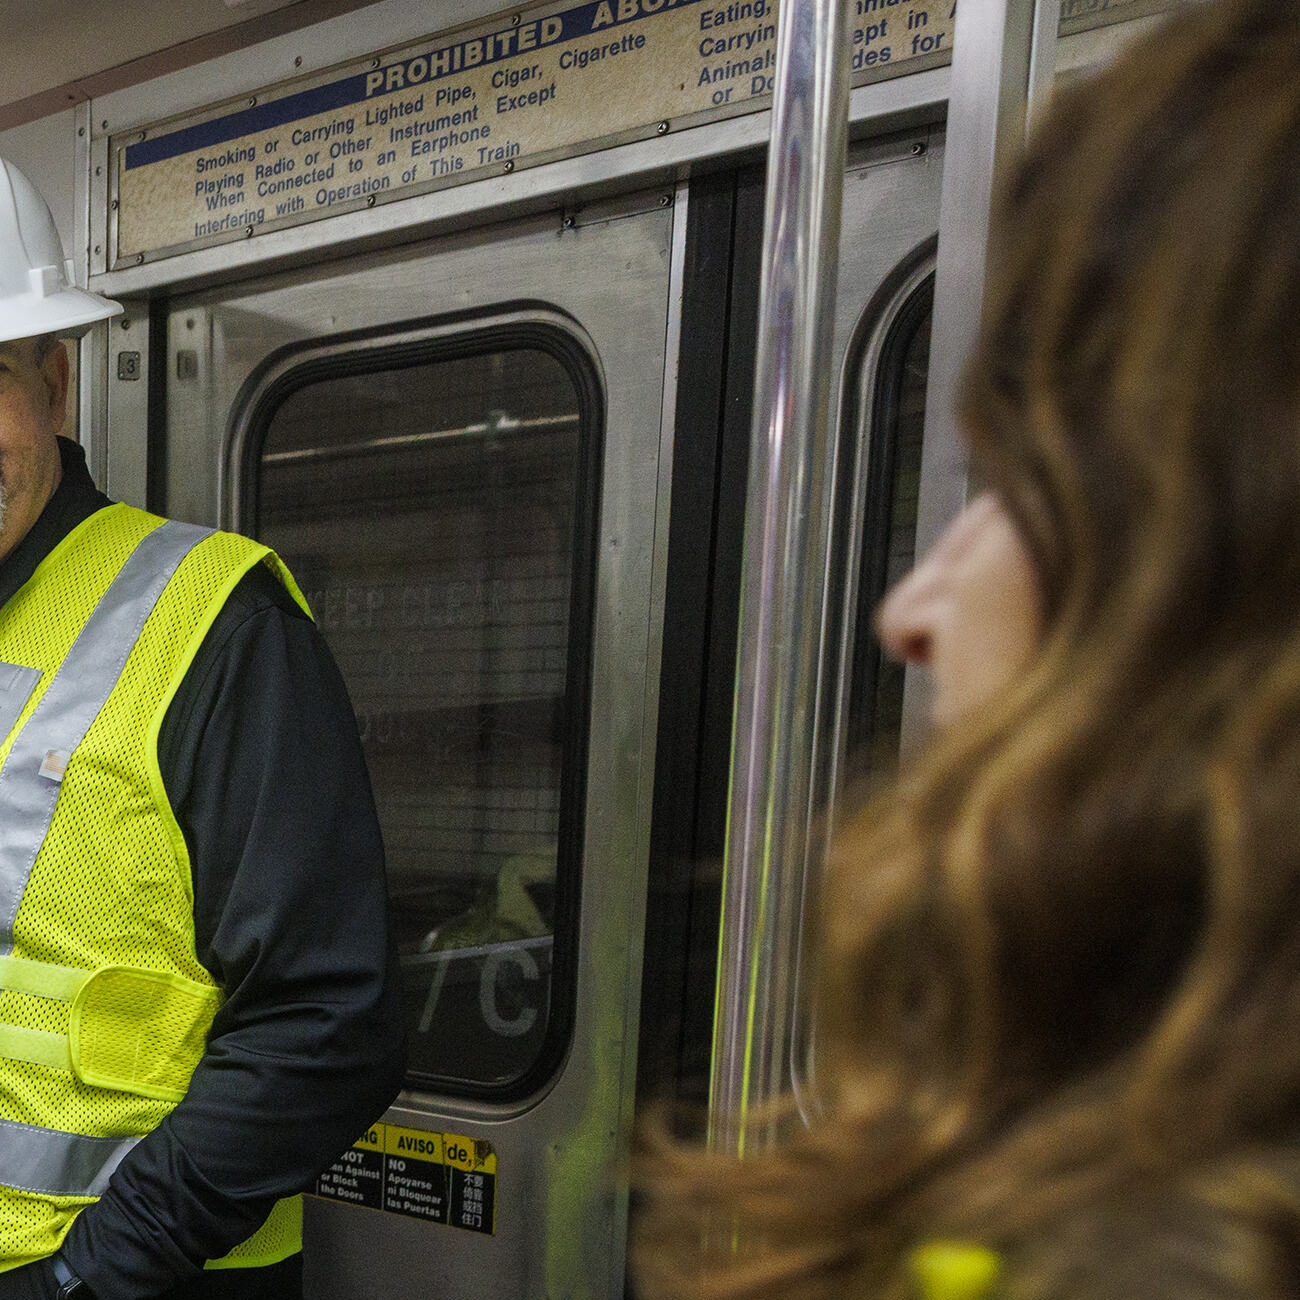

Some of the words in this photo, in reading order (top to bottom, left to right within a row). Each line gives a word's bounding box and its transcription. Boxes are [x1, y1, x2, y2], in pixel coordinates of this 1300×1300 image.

[700, 0, 771, 30] Eating,
[908, 9, 928, 30] in
[699, 23, 775, 57] Carryin
[365, 16, 563, 97] PROHIBITED
[712, 87, 733, 105] or
[912, 32, 945, 54] for
[196, 146, 256, 173] Smoking
[265, 140, 279, 154] or
[292, 118, 355, 146] Carrying
[366, 95, 423, 126] Lighted
[436, 84, 476, 107] Pipe,
[492, 63, 542, 89] Cigar,
[559, 33, 646, 71] Cigarette
[195, 173, 244, 197] Playing
[256, 158, 295, 180] Radio
[305, 152, 319, 166] or
[330, 137, 372, 159] Other
[390, 105, 478, 143] Instrument
[496, 82, 556, 114] Except
[206, 189, 245, 211] When
[258, 163, 334, 197] Connected
[349, 158, 363, 173] to
[377, 150, 396, 166] an
[411, 125, 491, 157] Earphone
[195, 207, 265, 237] Interfering
[276, 195, 304, 216] with
[316, 174, 390, 206] Operation
[402, 165, 417, 183] of
[430, 155, 463, 177] This
[477, 141, 521, 165] Train
[127, 358, 136, 374] 3
[397, 1136, 435, 1155] AVISO
[447, 1143, 472, 1167] de,
[345, 1164, 380, 1180] Against
[388, 1158, 406, 1172] NO
[321, 1173, 331, 1182] or
[333, 1174, 358, 1187] Block
[321, 1184, 335, 1194] the
[338, 1187, 364, 1200] Doors
[388, 1172, 432, 1190] Apoyarse
[387, 1197, 401, 1208] las
[404, 1201, 440, 1217] Puertas
[388, 1186, 397, 1195] ni
[400, 1187, 442, 1204] Bloquear
